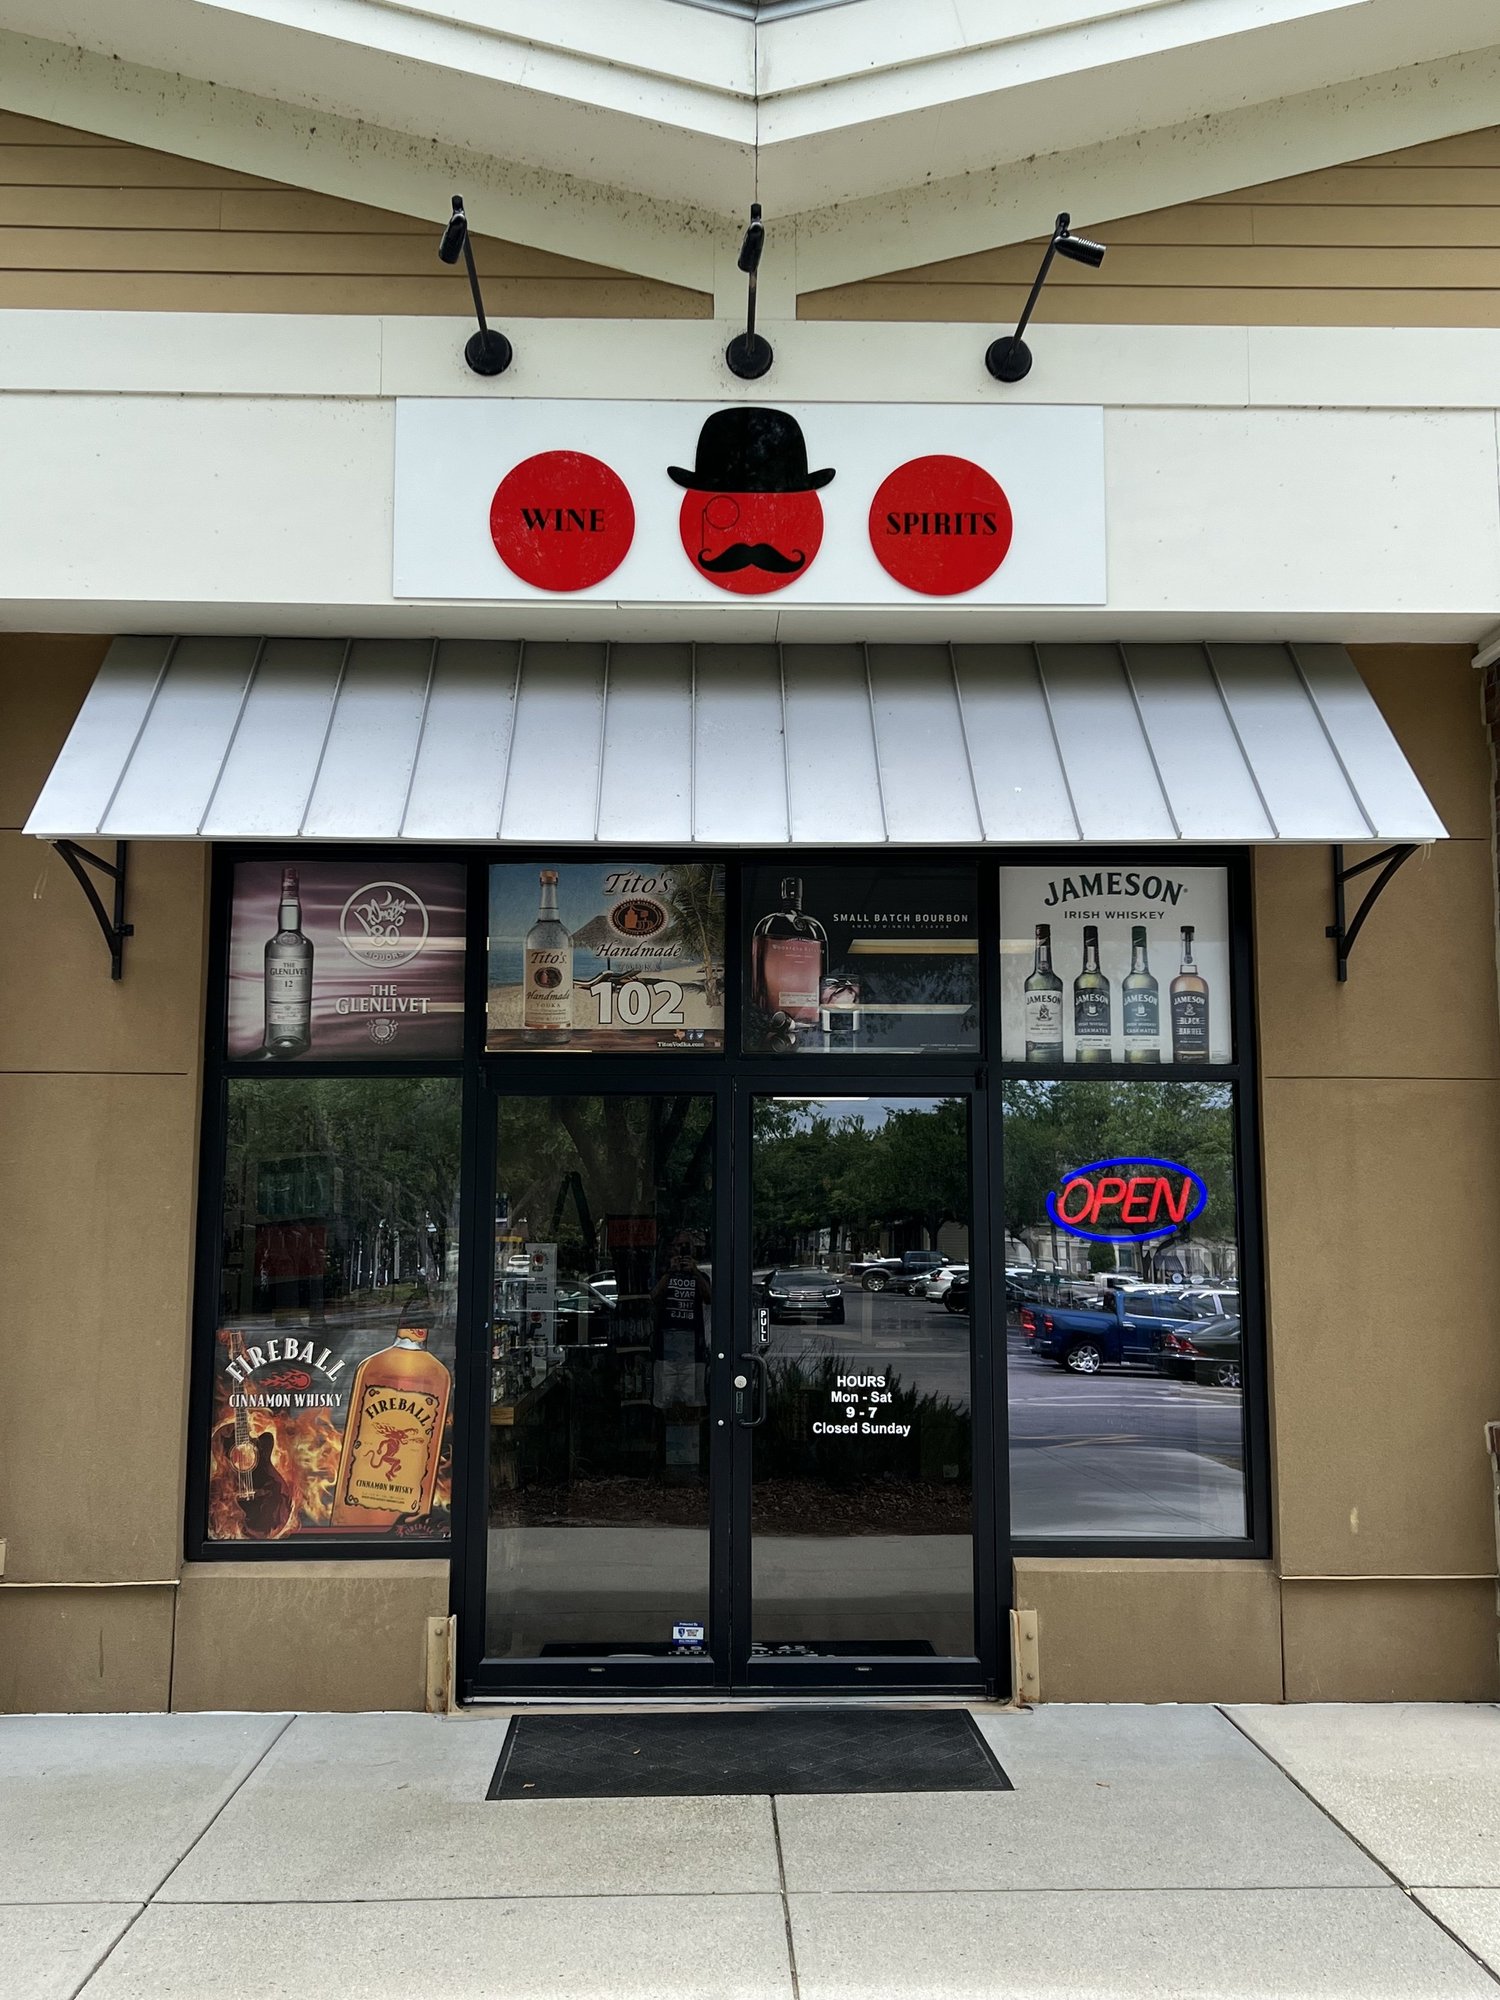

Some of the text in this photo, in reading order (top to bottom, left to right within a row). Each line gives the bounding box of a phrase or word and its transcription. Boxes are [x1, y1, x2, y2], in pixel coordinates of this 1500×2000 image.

[520, 508, 606, 532] WINE
[886, 512, 997, 535] SPIRITS
[605, 869, 673, 894] Tito's
[1044, 872, 1184, 906] JAMESON
[833, 914, 968, 922] SMALL BATCH BOURBON
[1064, 911, 1165, 919] IRISH WHISKEY
[370, 925, 400, 947] 80
[364, 951, 405, 961] LIQUORS
[596, 941, 682, 957] Handmade
[370, 985, 397, 996] THE
[335, 998, 431, 1014] GLENLIVET
[590, 981, 684, 1024] 102
[1123, 994, 1158, 1006] JAMESON
[1057, 1177, 1191, 1224] OPEN
[225, 1338, 346, 1382] FIREBALL
[837, 1375, 885, 1387] HOURS
[229, 1394, 342, 1407] CINNAMON WHISKY
[831, 1391, 859, 1403] Mon
[870, 1391, 892, 1403] Sat
[365, 1397, 431, 1427] FIREBALL
[846, 1406, 855, 1418] 9
[868, 1406, 878, 1418] 7
[812, 1422, 911, 1437] Closed Sunday
[356, 1479, 414, 1495] CINNAMON WHISKY
